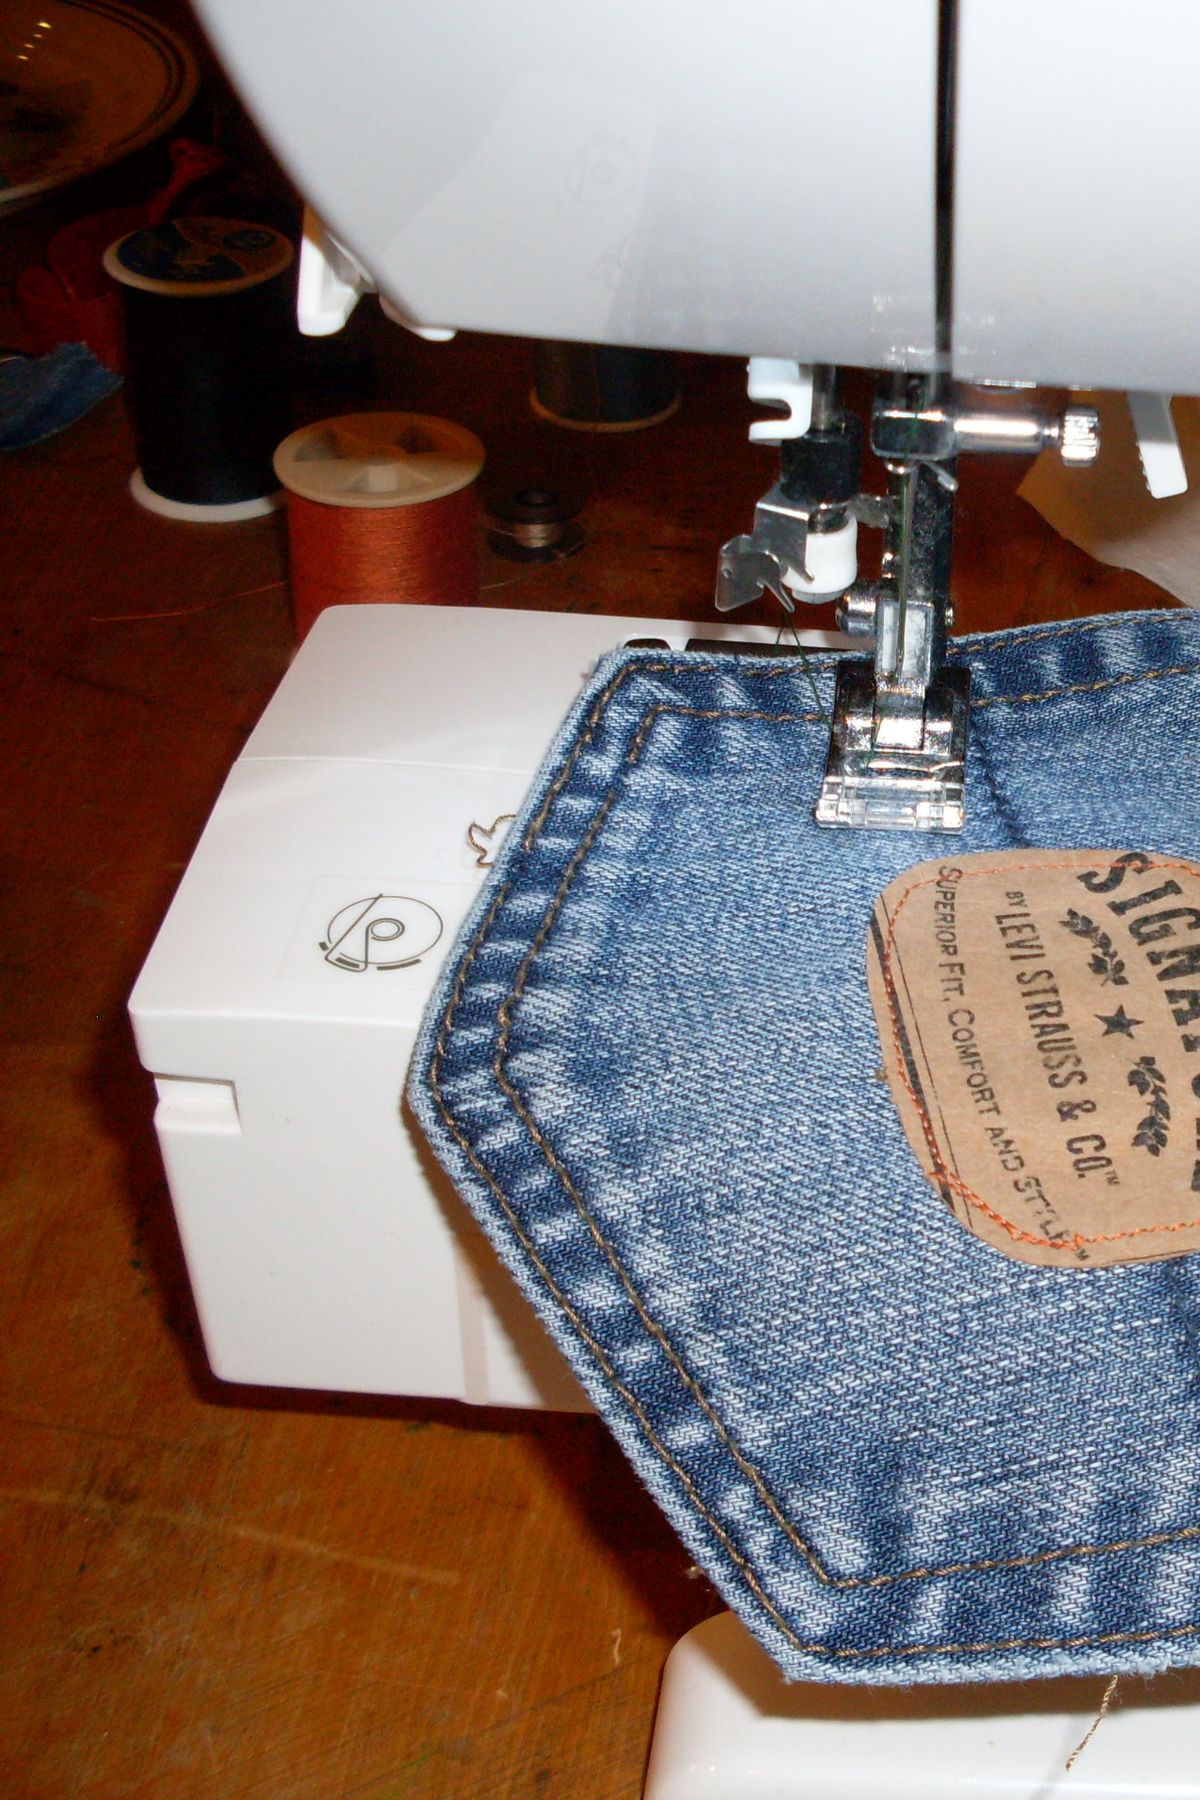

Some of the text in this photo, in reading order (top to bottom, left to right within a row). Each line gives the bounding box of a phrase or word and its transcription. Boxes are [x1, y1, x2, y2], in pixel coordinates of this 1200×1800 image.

[933, 864, 963, 956] SUPERIOR
[1005, 891, 1028, 908] BY
[995, 912, 1046, 961] LEVI
[1016, 969, 1088, 1089] STRAUSS
[947, 1008, 1001, 1116] COMFORT
[1056, 1099, 1097, 1122] &
[984, 1126, 1025, 1172] AND
